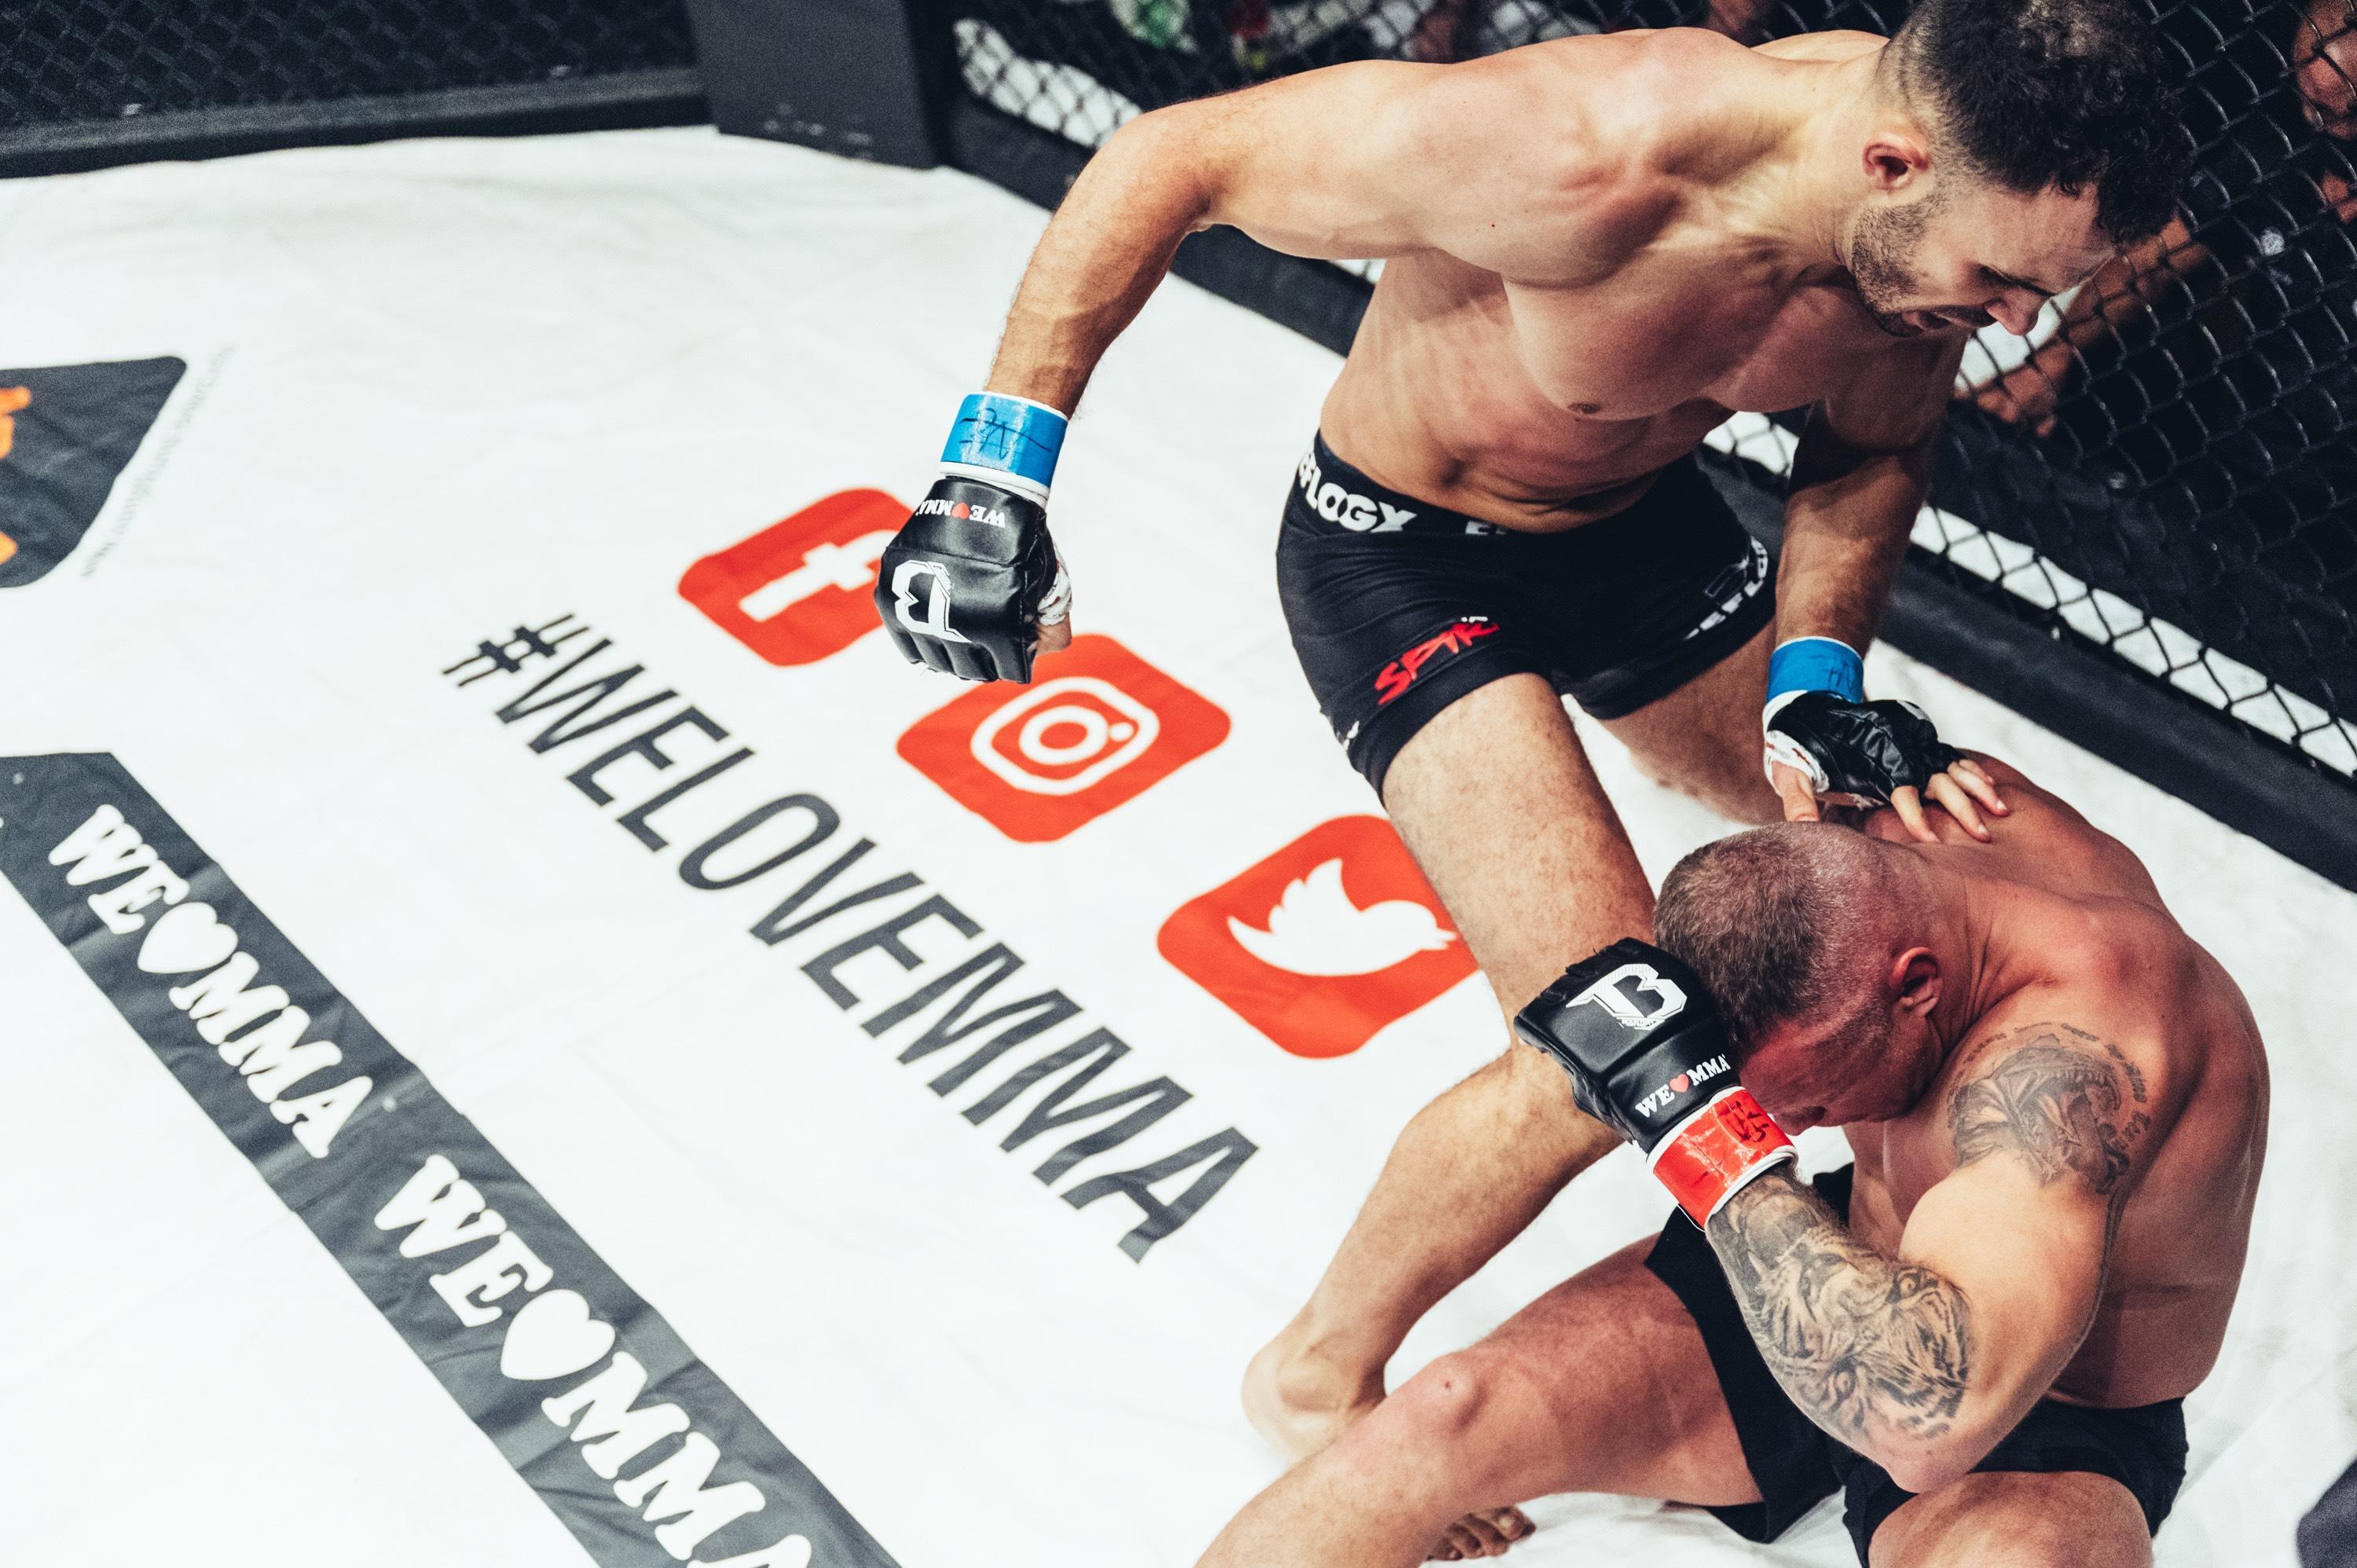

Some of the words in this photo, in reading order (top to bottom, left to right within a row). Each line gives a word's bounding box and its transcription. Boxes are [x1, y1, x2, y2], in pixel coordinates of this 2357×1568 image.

[970, 504, 1006, 528] WE
[49, 804, 190, 936] WE
[168, 951, 374, 1160] MMA
[442, 614, 1259, 1264] #WELOVEMMA
[1635, 1084, 1675, 1118] WE
[1686, 1054, 1731, 1086] MMA
[374, 1154, 554, 1328] WE
